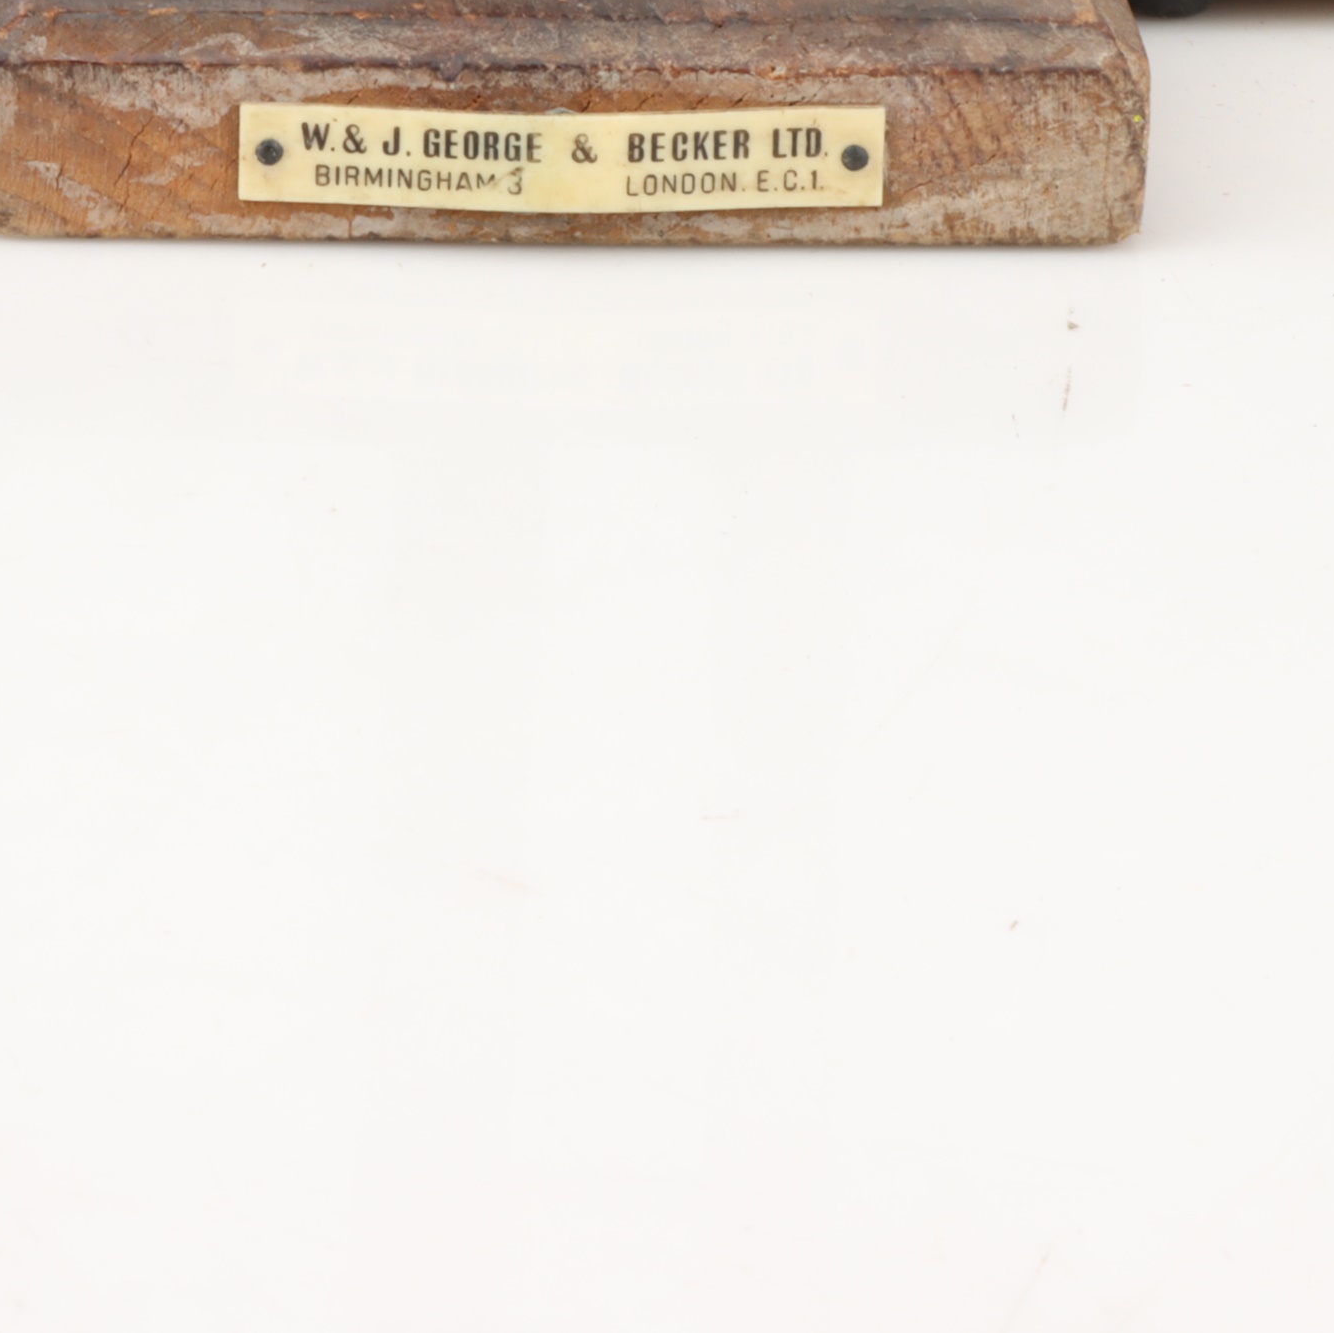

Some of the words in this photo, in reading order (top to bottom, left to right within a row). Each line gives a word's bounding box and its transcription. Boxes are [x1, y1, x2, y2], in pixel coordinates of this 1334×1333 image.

[301, 122, 336, 151] W.
[342, 124, 367, 154] &
[382, 126, 411, 156] J.
[423, 128, 543, 163] GEORGE
[571, 133, 598, 164] &
[627, 129, 750, 163] BECKER
[772, 127, 828, 159] LTD.
